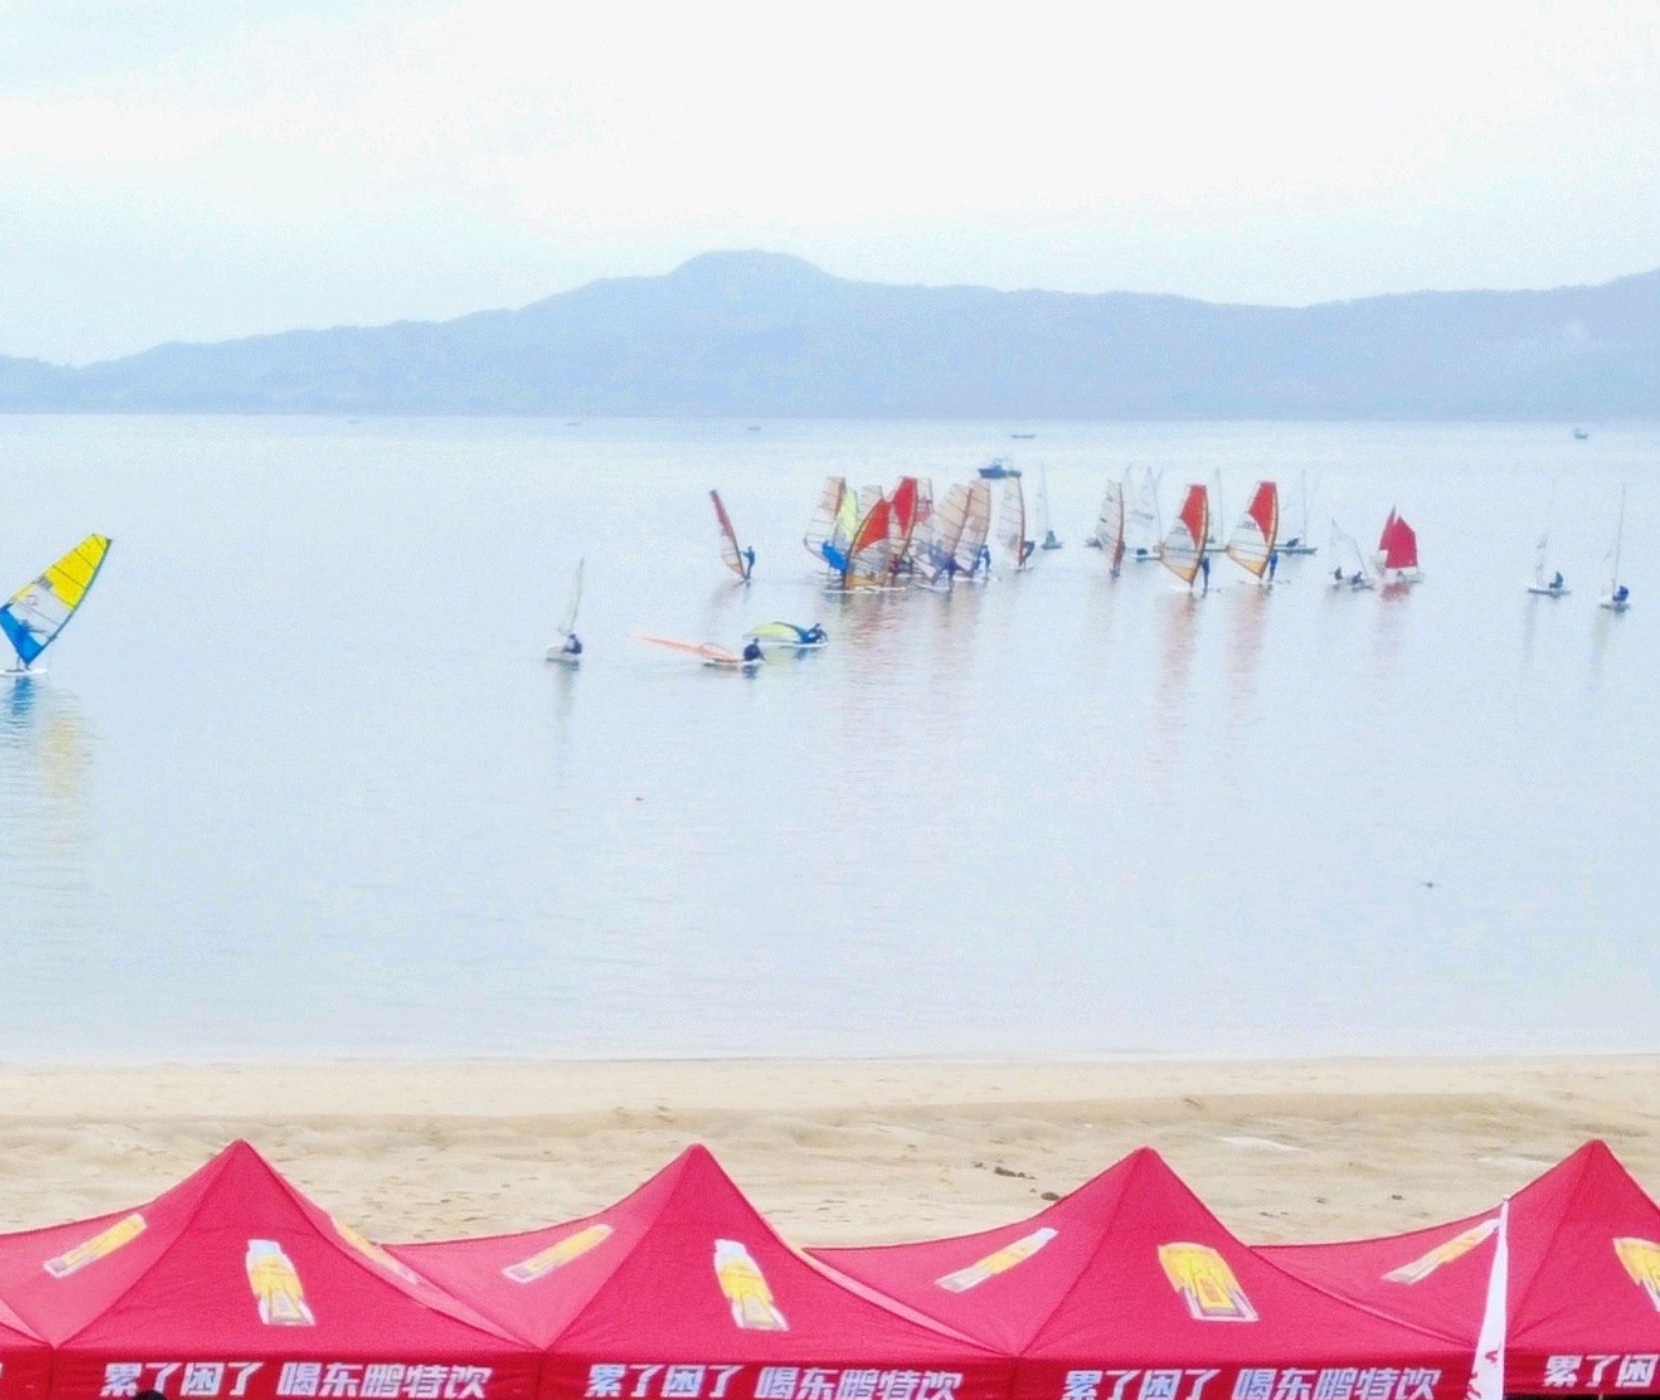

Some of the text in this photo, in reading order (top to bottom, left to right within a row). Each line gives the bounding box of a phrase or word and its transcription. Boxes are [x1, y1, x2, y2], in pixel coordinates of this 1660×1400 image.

[100, 1361, 493, 1399] 累了困了 喝东鹏特饮
[584, 1363, 745, 1398] 累了困了
